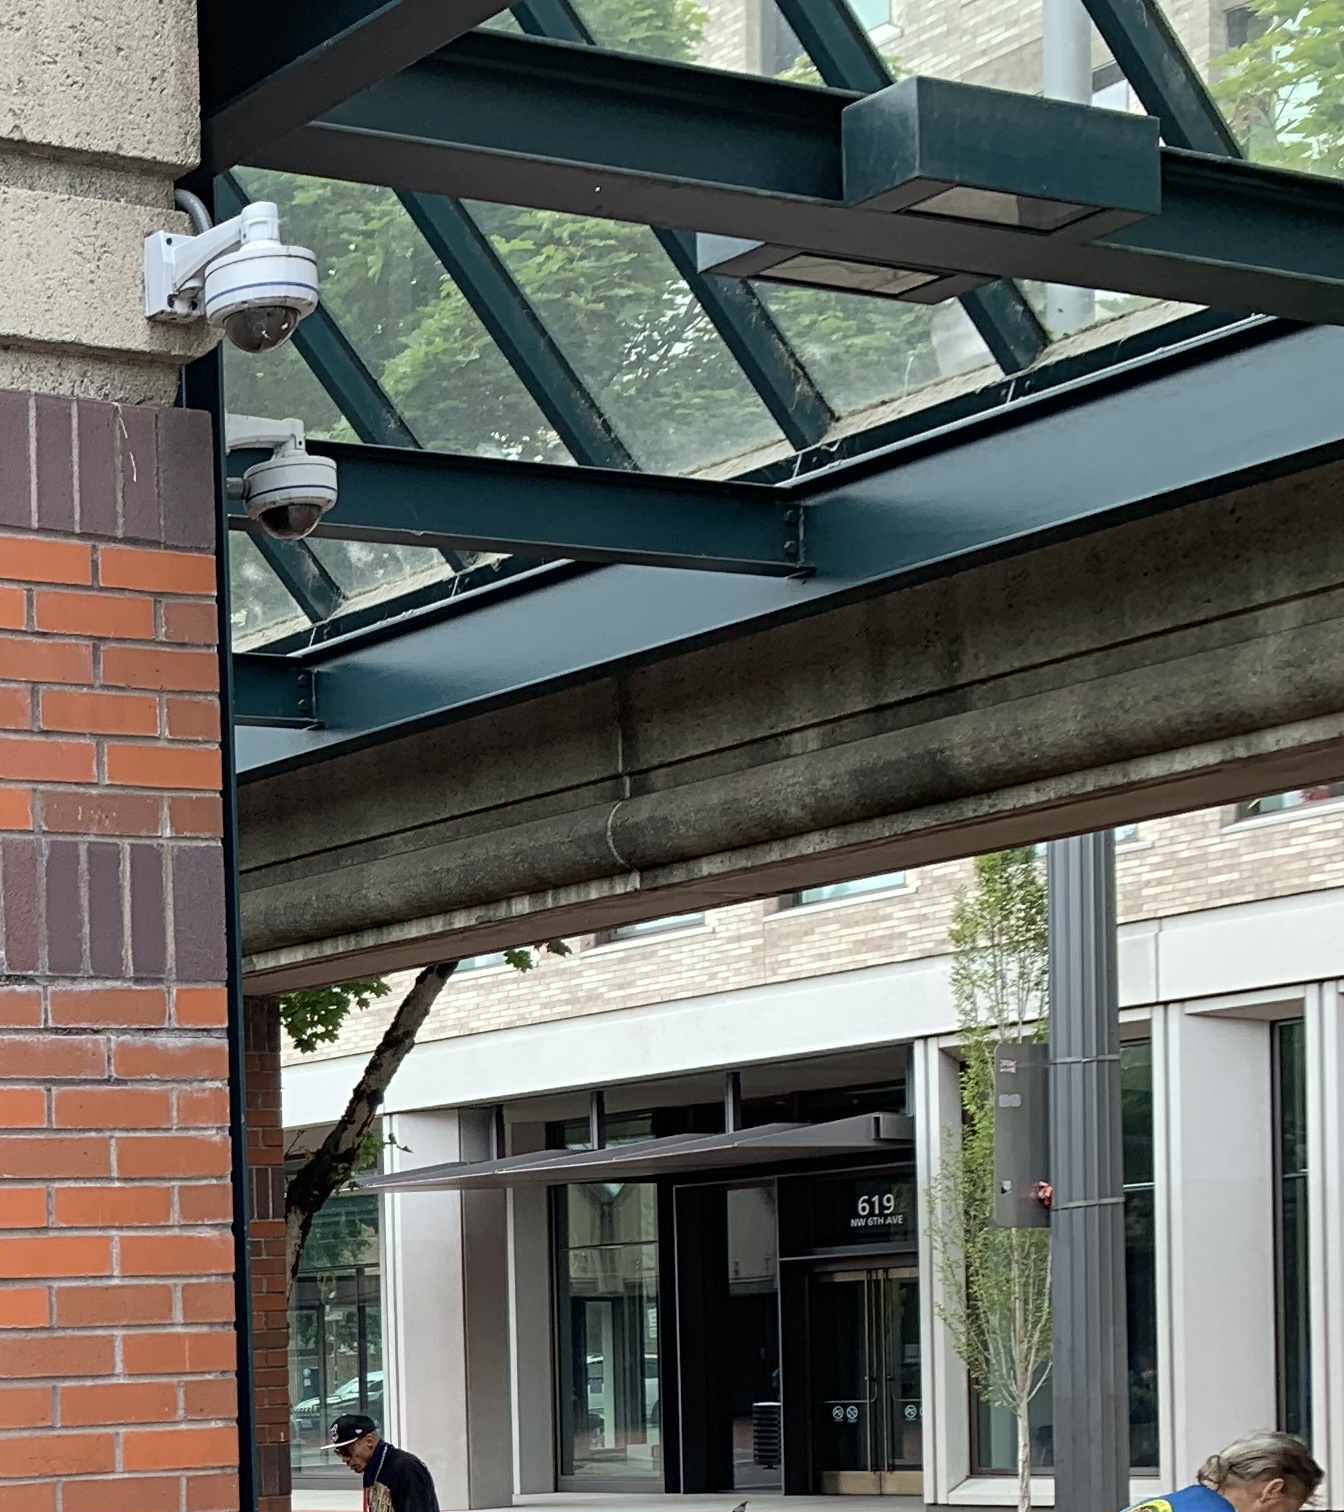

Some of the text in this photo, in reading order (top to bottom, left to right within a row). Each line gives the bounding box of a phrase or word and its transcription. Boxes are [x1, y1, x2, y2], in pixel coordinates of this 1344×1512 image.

[858, 1194, 895, 1215] 619
[850, 1215, 903, 1227] NW 6TH AVE
